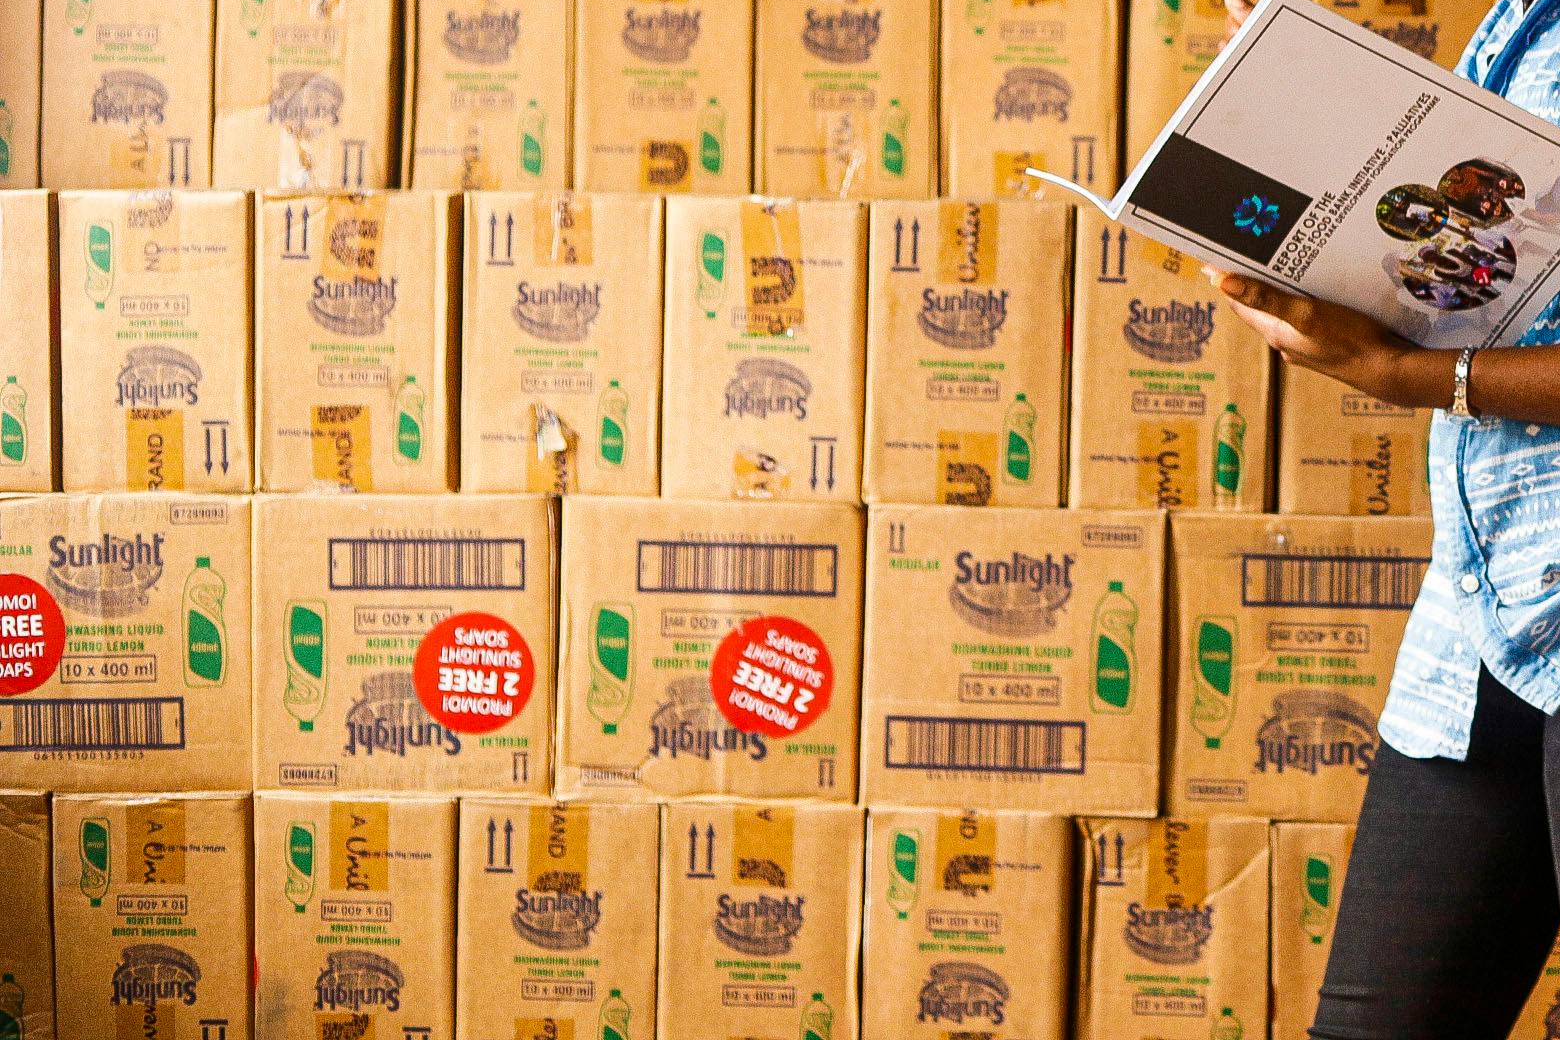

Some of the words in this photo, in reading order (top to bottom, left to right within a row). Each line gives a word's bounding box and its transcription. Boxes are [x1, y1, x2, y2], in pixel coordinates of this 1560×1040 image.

[1284, 244, 1312, 279] LAGOS
[1308, 216, 1332, 244] FOOD
[1328, 189, 1352, 216] BANK
[1347, 147, 1386, 191] INITIATIVE
[1386, 92, 1431, 143] PALLIATIVES
[1294, 248, 1320, 283] DONATED
[1316, 238, 1327, 248] TO
[1335, 177, 1374, 224] DEVELOPMENT
[1370, 137, 1407, 180] FOUNDATION
[1404, 95, 1441, 138] PROGRAMME
[1272, 229, 1306, 273] REPORT
[1303, 211, 1319, 228] OF
[1314, 190, 1336, 212] THE
[312, 275, 398, 305] Sunlight
[517, 281, 602, 311] Sunlight
[923, 288, 1009, 318] Sunlight
[1129, 298, 1214, 329] Sunlight
[115, 378, 200, 407] Sunlight
[723, 392, 806, 420] Sunlight
[50, 533, 165, 572] Sunlight
[956, 551, 1074, 592] Sunlight
[0, 594, 37, 610] MO!
[0, 614, 44, 637] REE
[66, 624, 123, 636] HWASHING
[127, 624, 164, 636] LIQUID
[455, 627, 510, 648] SOAPS
[0, 642, 44, 658] LIGHT
[106, 641, 145, 652] LEMON
[439, 645, 522, 669] SUNLIGHT
[766, 629, 819, 664] SOAPS
[64, 663, 82, 677] 10
[88, 667, 95, 676] x
[100, 663, 129, 677] 400
[134, 662, 154, 675] ml
[742, 641, 824, 688] SUNLIGHT
[438, 667, 498, 694] FREE
[503, 672, 520, 696] 2
[732, 660, 794, 704] FREE
[442, 695, 513, 717] PROMO!
[729, 688, 799, 731] PROMO!
[793, 688, 815, 713] 2
[346, 717, 461, 756] Sunlight
[650, 722, 768, 761] Sunlight
[1255, 736, 1375, 776] Sunlight
[136, 900, 157, 911] 400
[171, 899, 187, 911] 10
[516, 890, 602, 920] Sunlight
[717, 893, 804, 923] Sunlight
[111, 976, 197, 1006] Sunlight
[314, 982, 400, 1012] Sunlight
